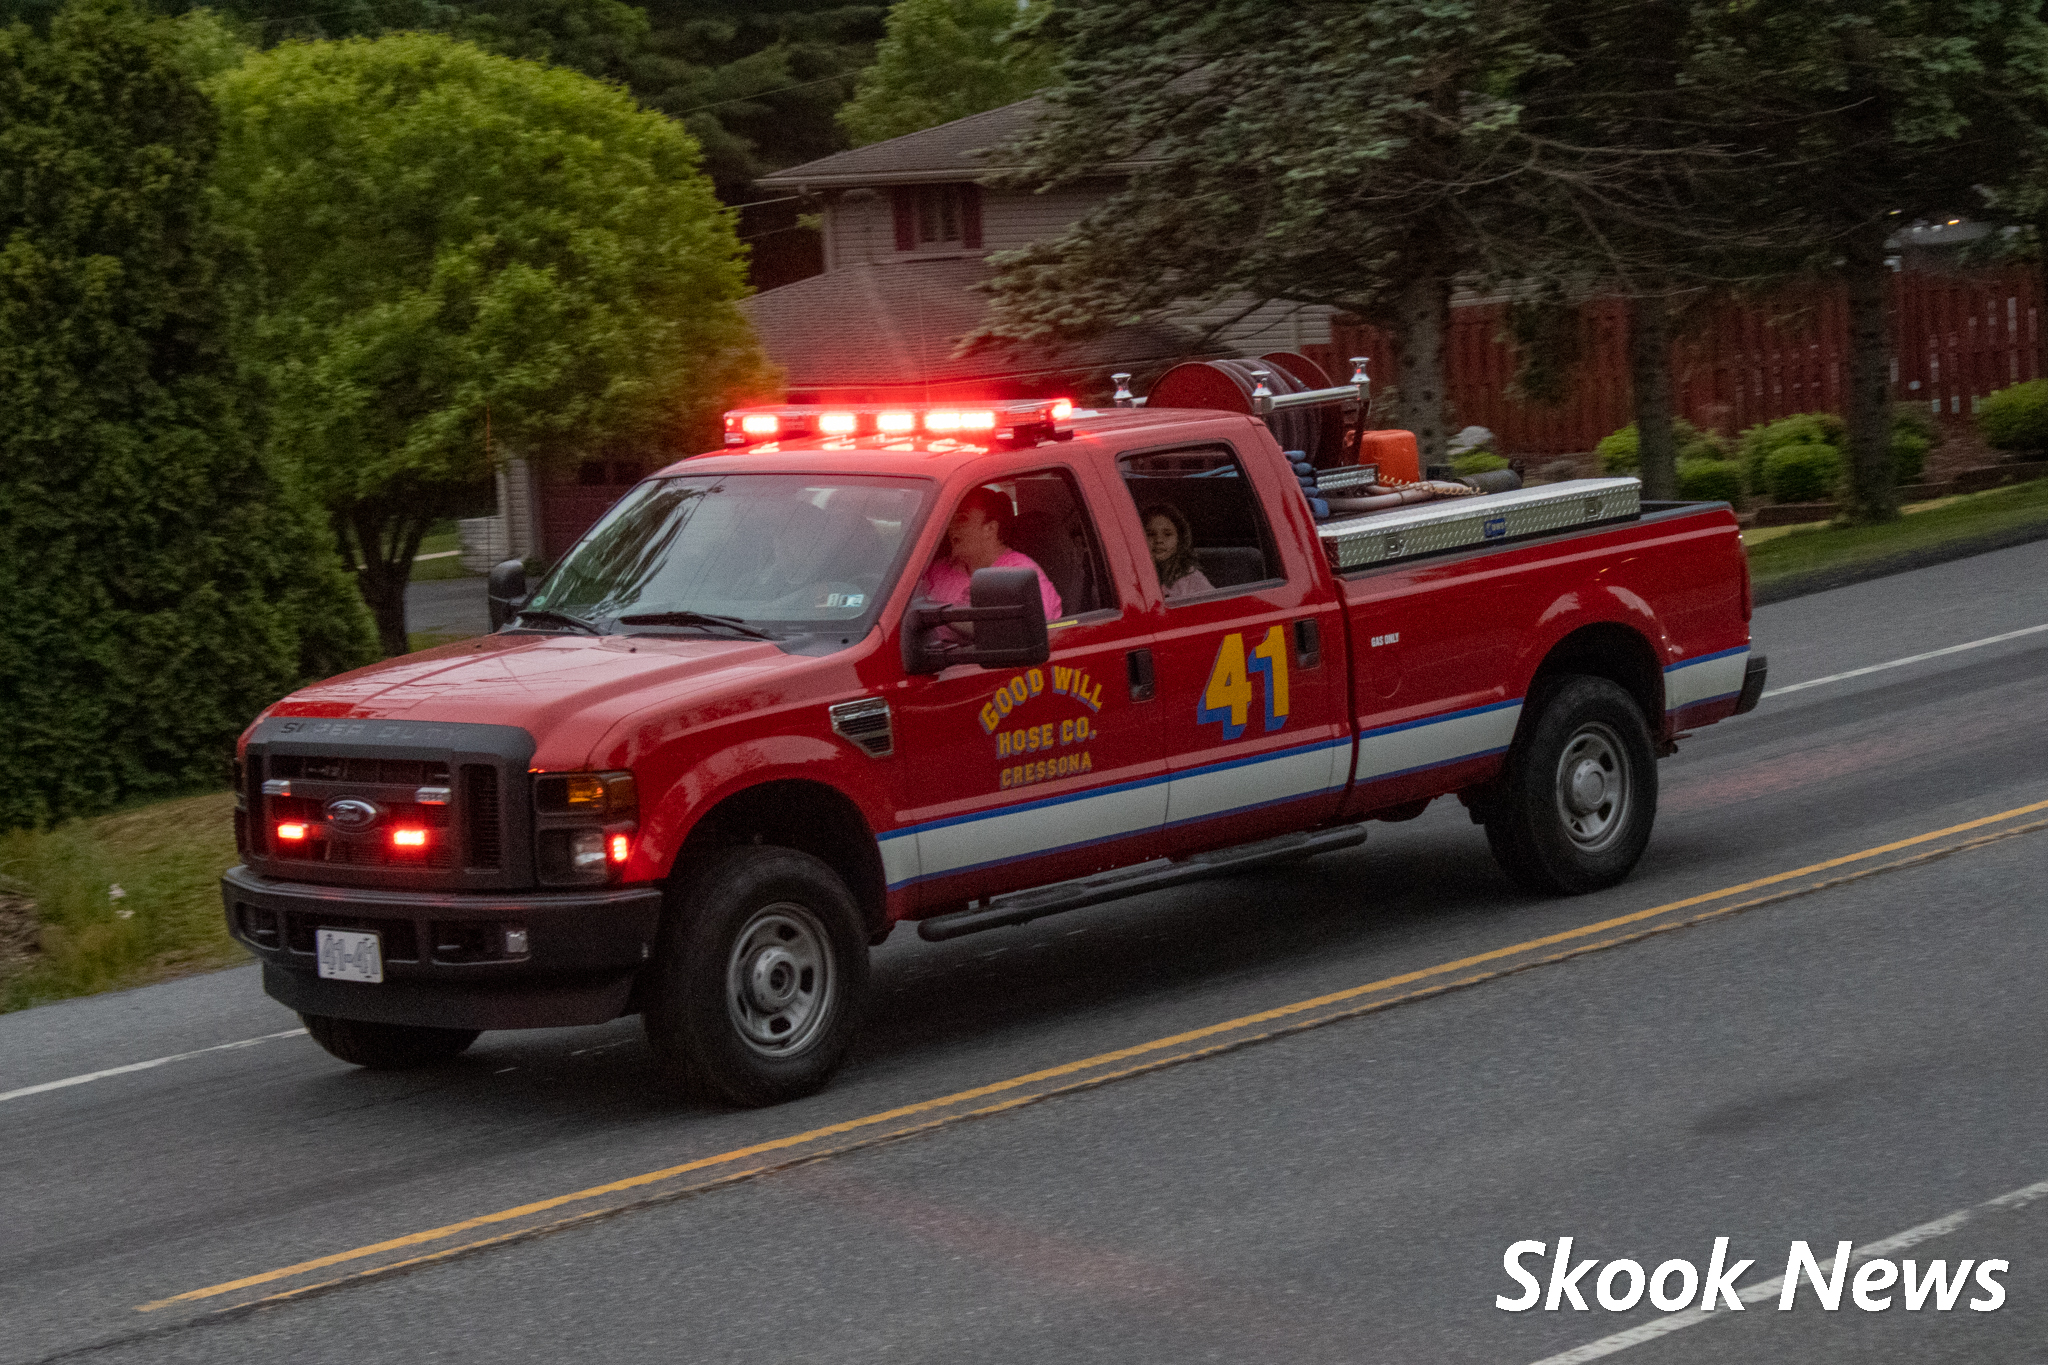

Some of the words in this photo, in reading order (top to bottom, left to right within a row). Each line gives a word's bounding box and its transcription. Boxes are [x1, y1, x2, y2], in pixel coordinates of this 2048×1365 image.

[979, 668, 1044, 735] GOOD
[1051, 665, 1103, 713] WILL
[1197, 624, 1289, 741] 41
[996, 723, 1054, 760] HOSE
[1060, 716, 1098, 746] CO.
[1000, 751, 1092, 789] CRESSONA
